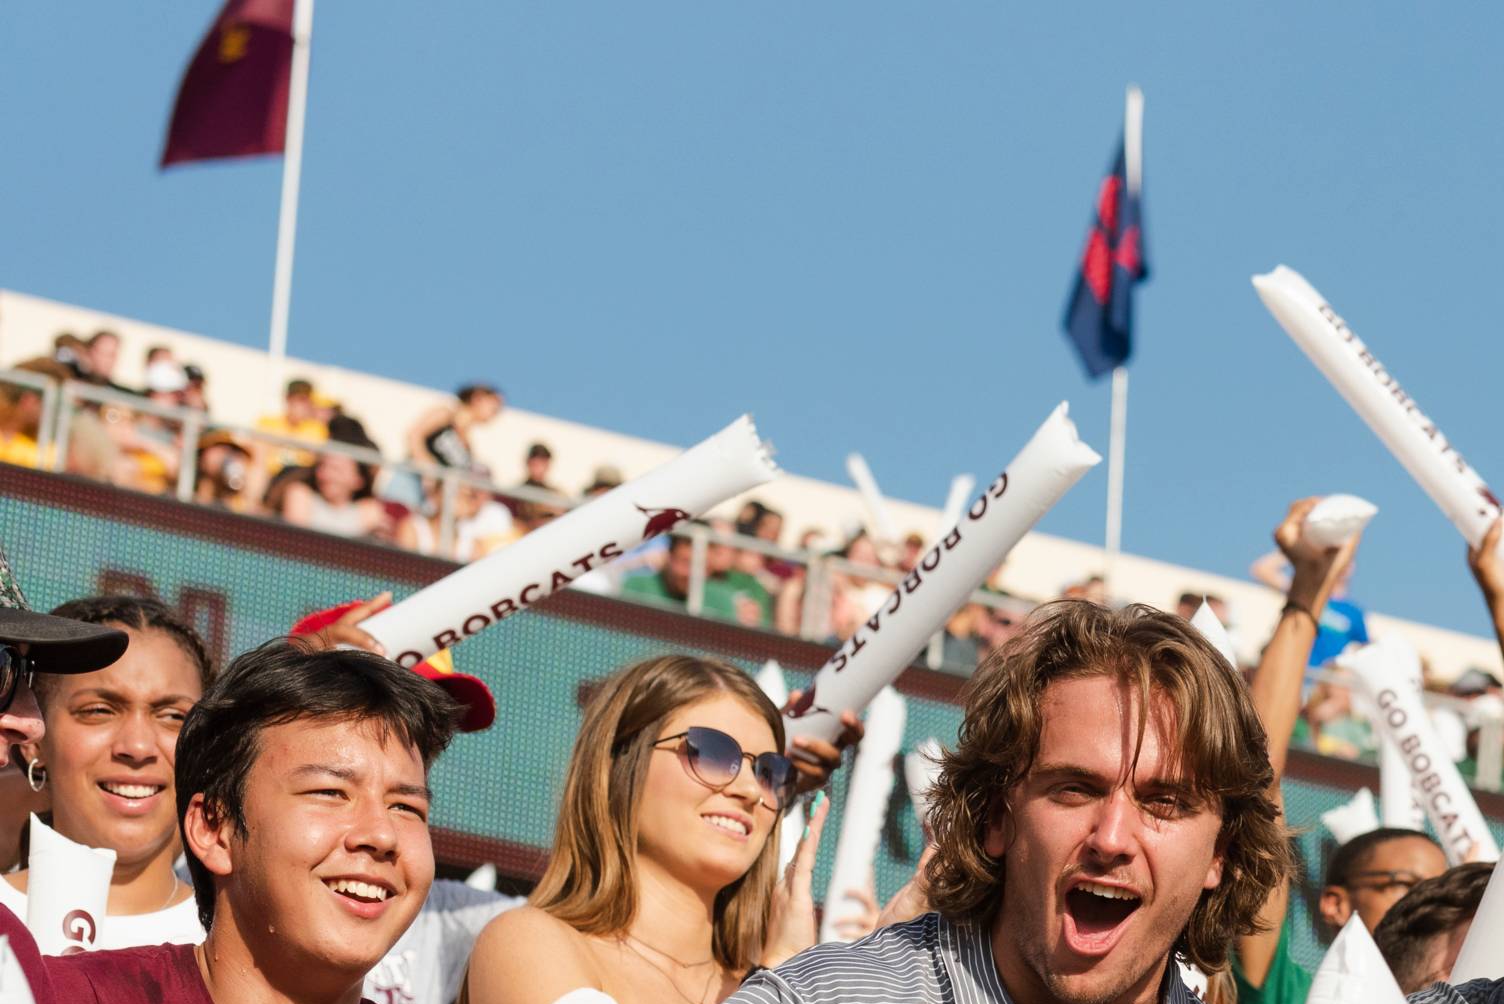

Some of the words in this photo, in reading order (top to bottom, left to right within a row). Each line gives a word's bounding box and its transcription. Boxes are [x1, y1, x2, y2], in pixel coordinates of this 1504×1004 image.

[432, 541, 624, 650] BOBCATS
[1378, 689, 1407, 728] GO
[1400, 735, 1473, 860] BOBCAT
